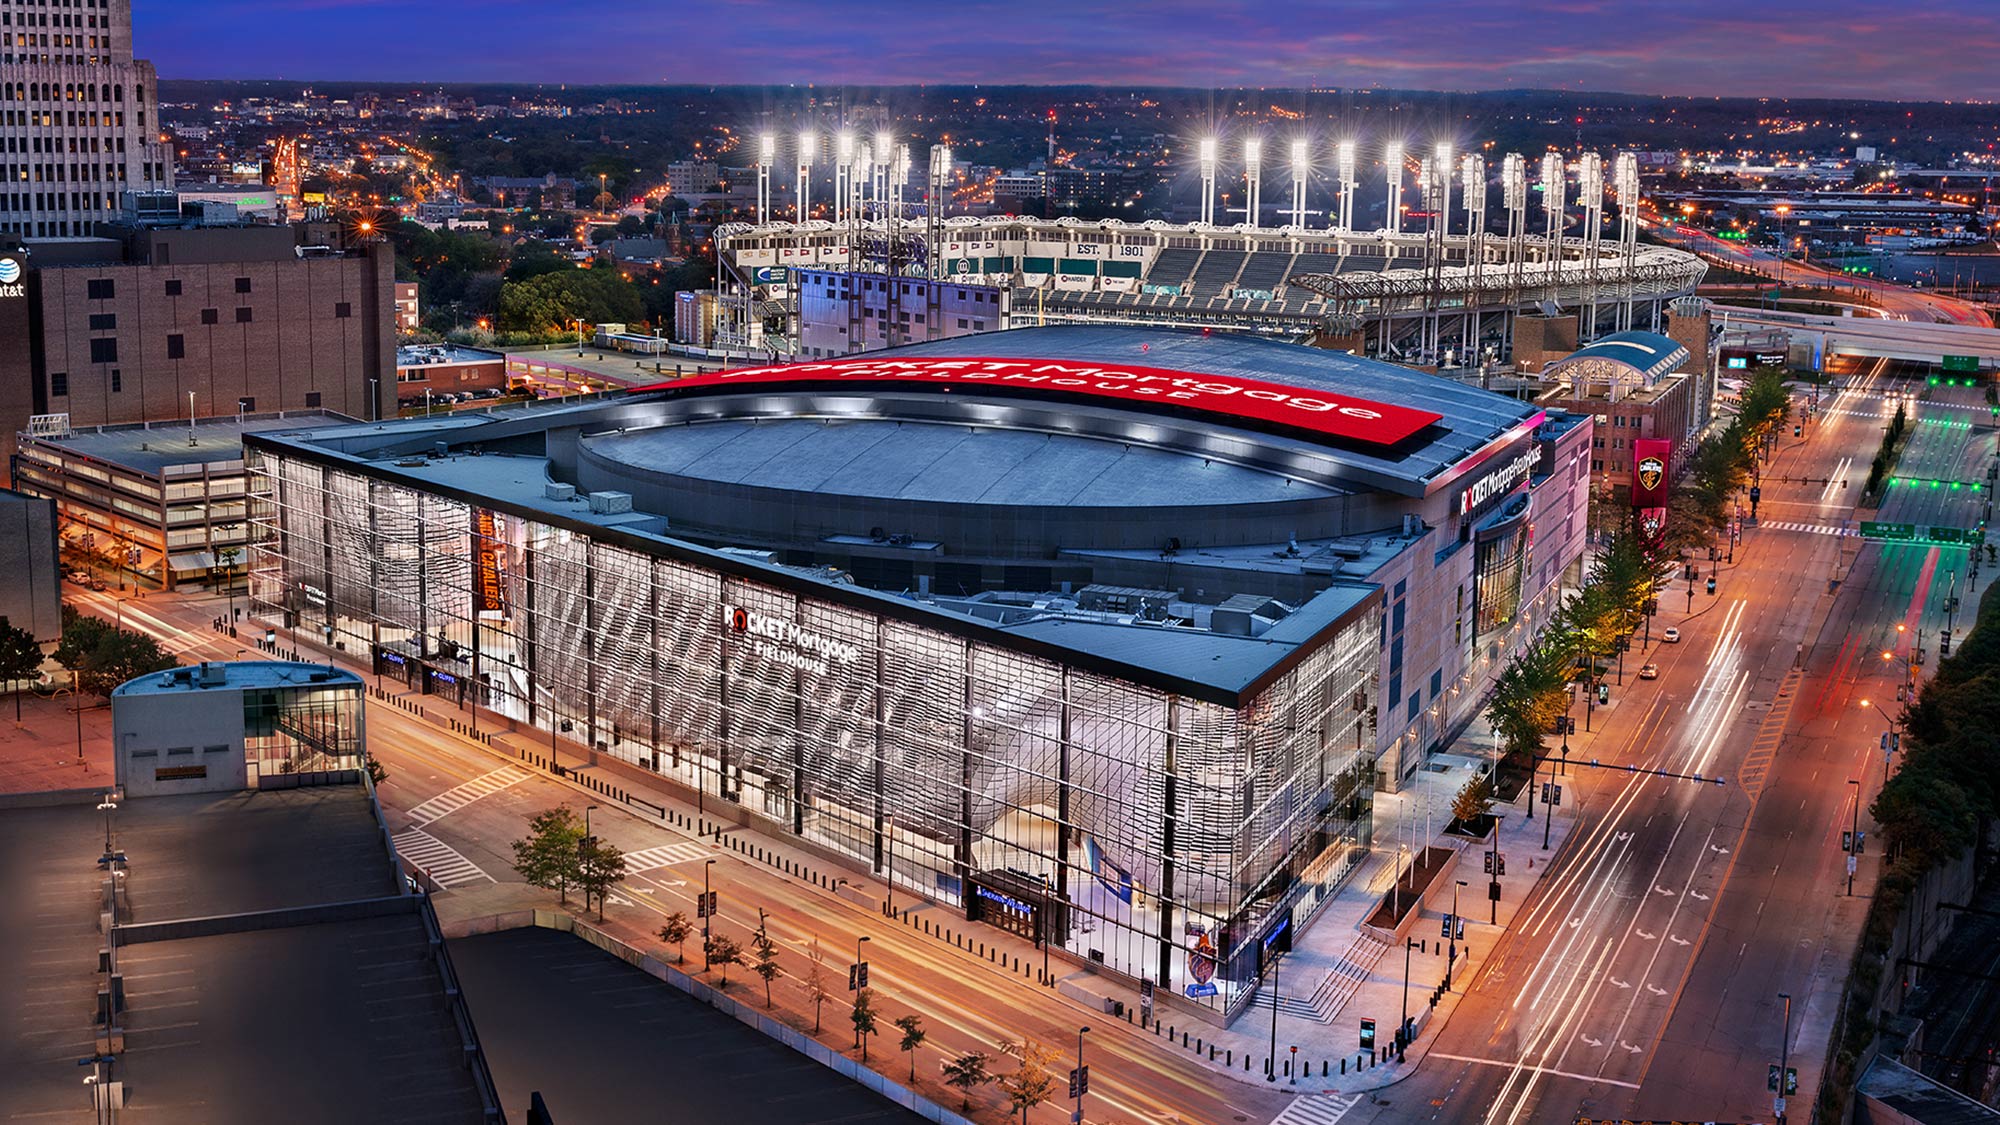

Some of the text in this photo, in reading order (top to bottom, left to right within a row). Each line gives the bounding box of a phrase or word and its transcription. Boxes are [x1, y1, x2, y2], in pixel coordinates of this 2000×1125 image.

[1077, 244, 1144, 257] EST. 1901
[1032, 364, 1382, 420] Mortgage
[1460, 476, 1489, 516] ROCKET
[481, 552, 500, 610] CAVALIERS
[724, 605, 859, 664] ROCKET Mortgage
